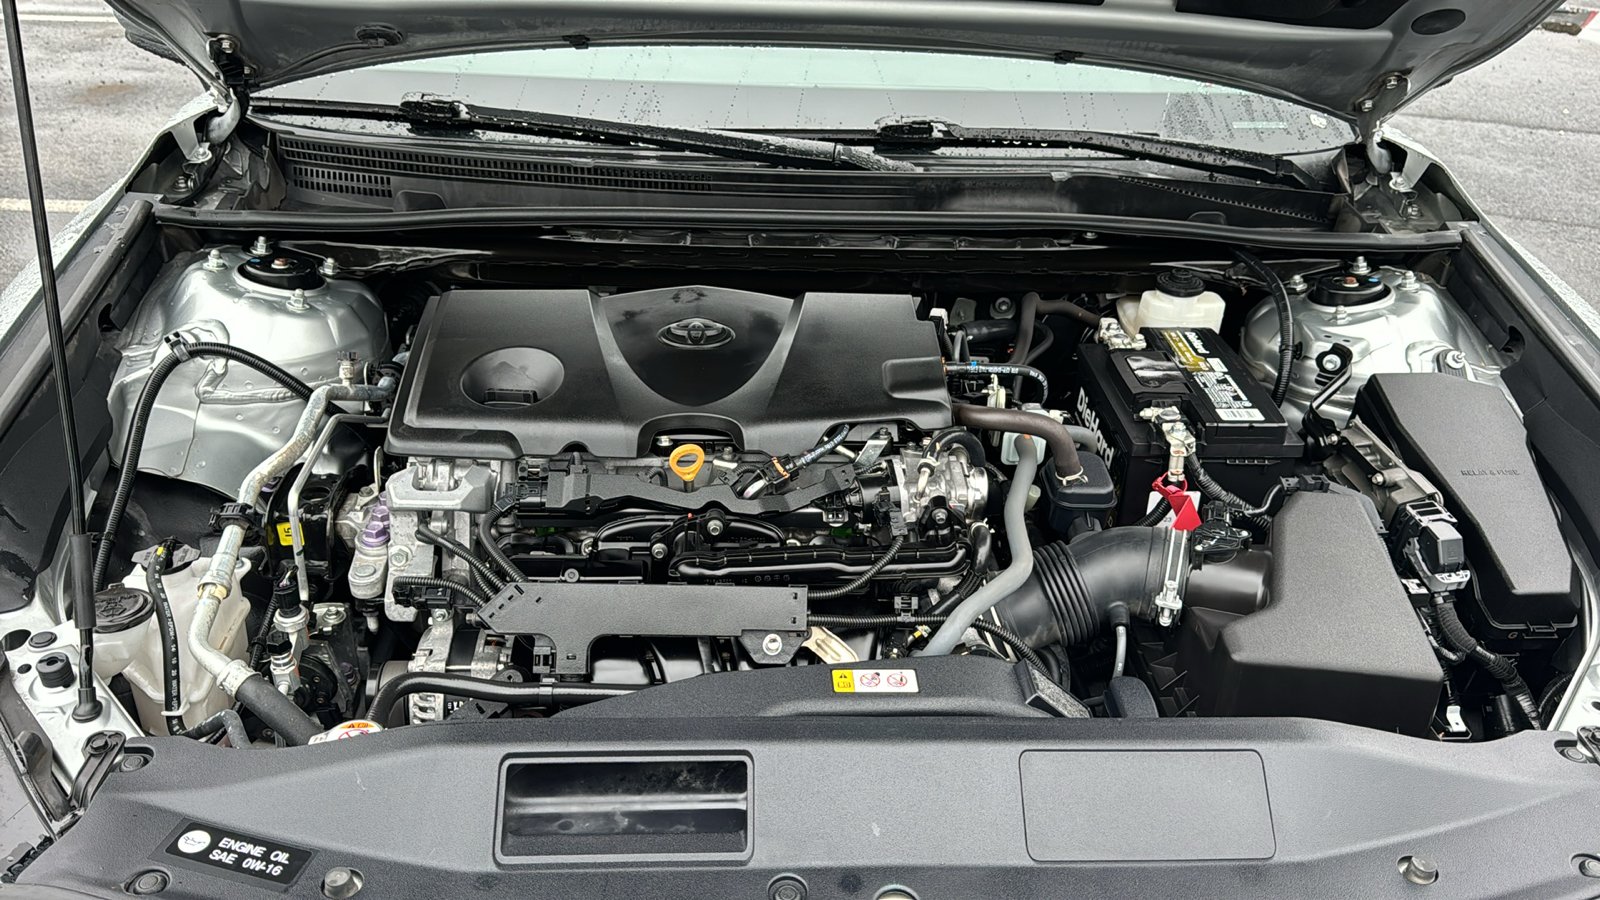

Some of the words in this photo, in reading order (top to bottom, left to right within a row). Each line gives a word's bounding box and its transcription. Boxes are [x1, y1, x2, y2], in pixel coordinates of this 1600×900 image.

[1076, 386, 1115, 470] DieHard
[162, 601, 171, 618] WATER
[209, 849, 238, 864] SAE
[241, 858, 283, 876] 0W-16
[218, 838, 266, 857] ENGINE
[270, 850, 290, 864] OIL
